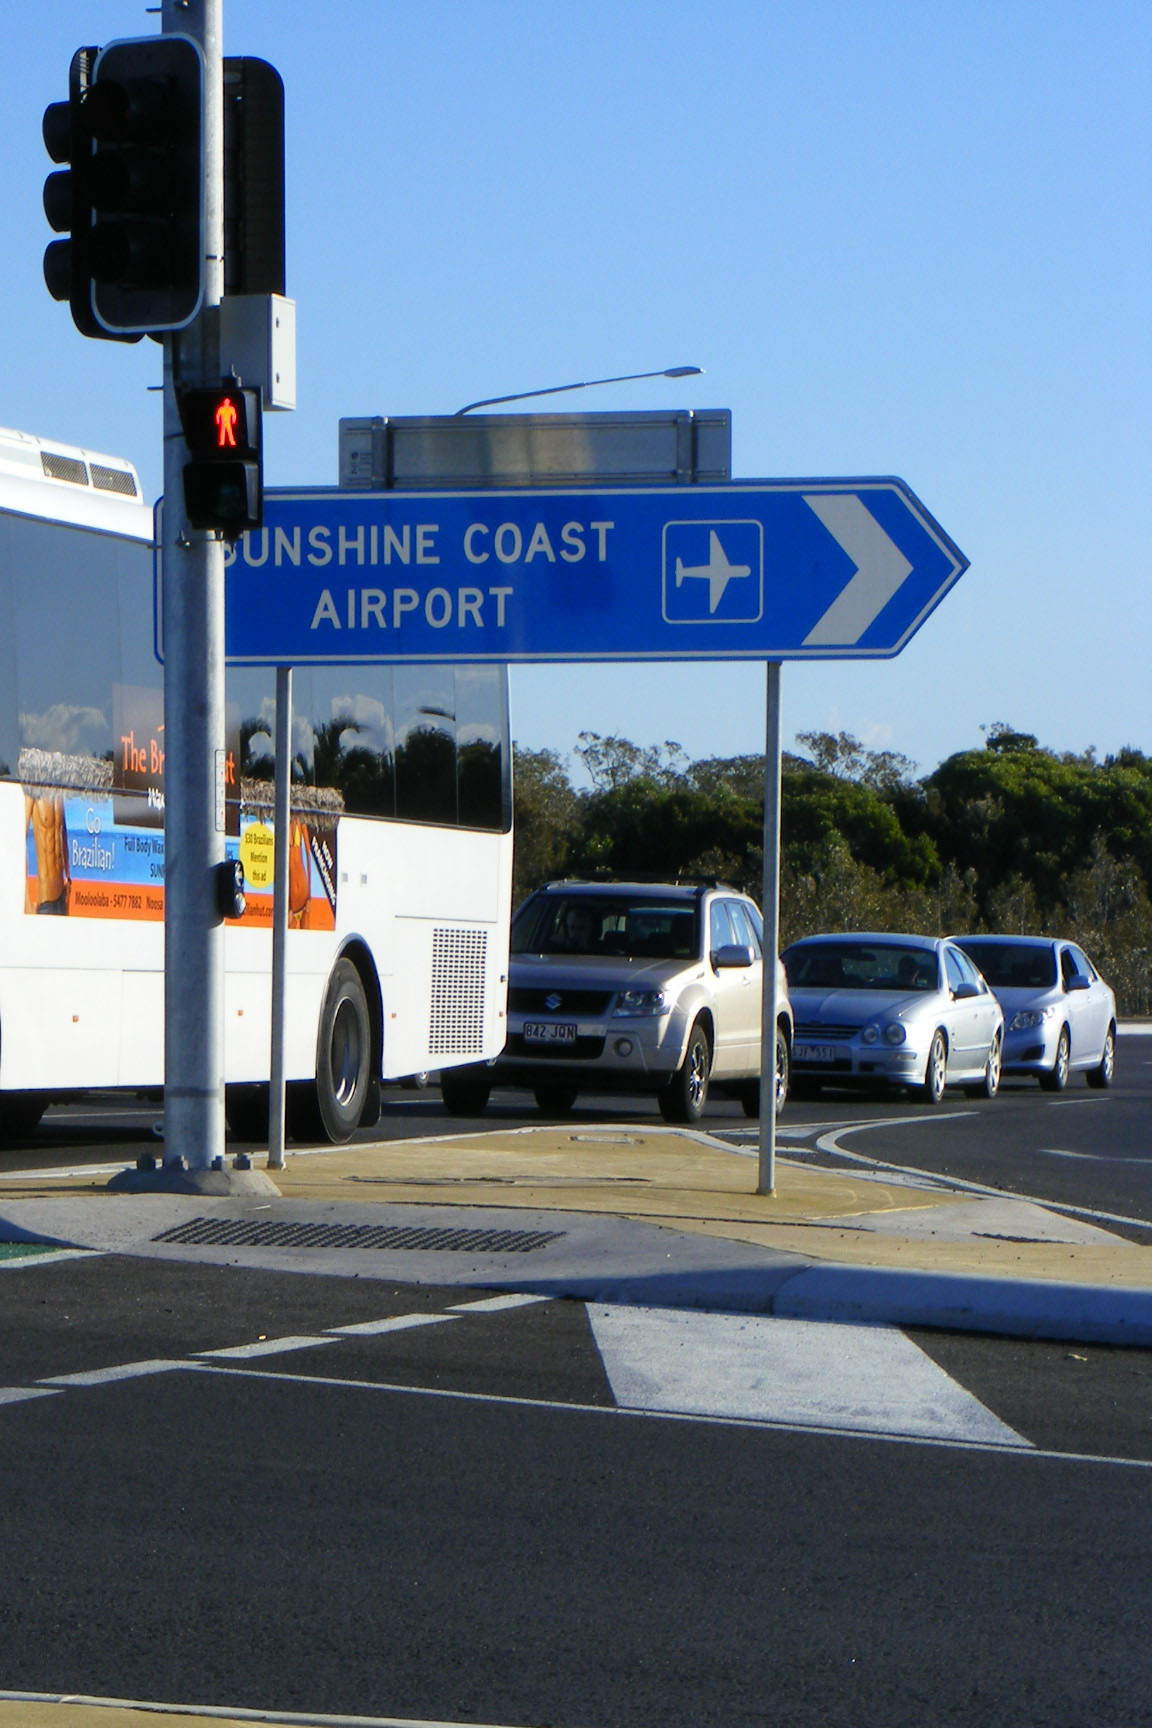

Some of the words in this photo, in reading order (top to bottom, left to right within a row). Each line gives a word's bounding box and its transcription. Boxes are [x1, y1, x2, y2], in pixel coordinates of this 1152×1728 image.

[463, 521, 615, 564] COAST
[310, 586, 513, 629] AIRPORT
[120, 730, 147, 773] The
[85, 807, 102, 834] Go
[72, 836, 115, 872] Brazilian!
[136, 837, 151, 857] Body
